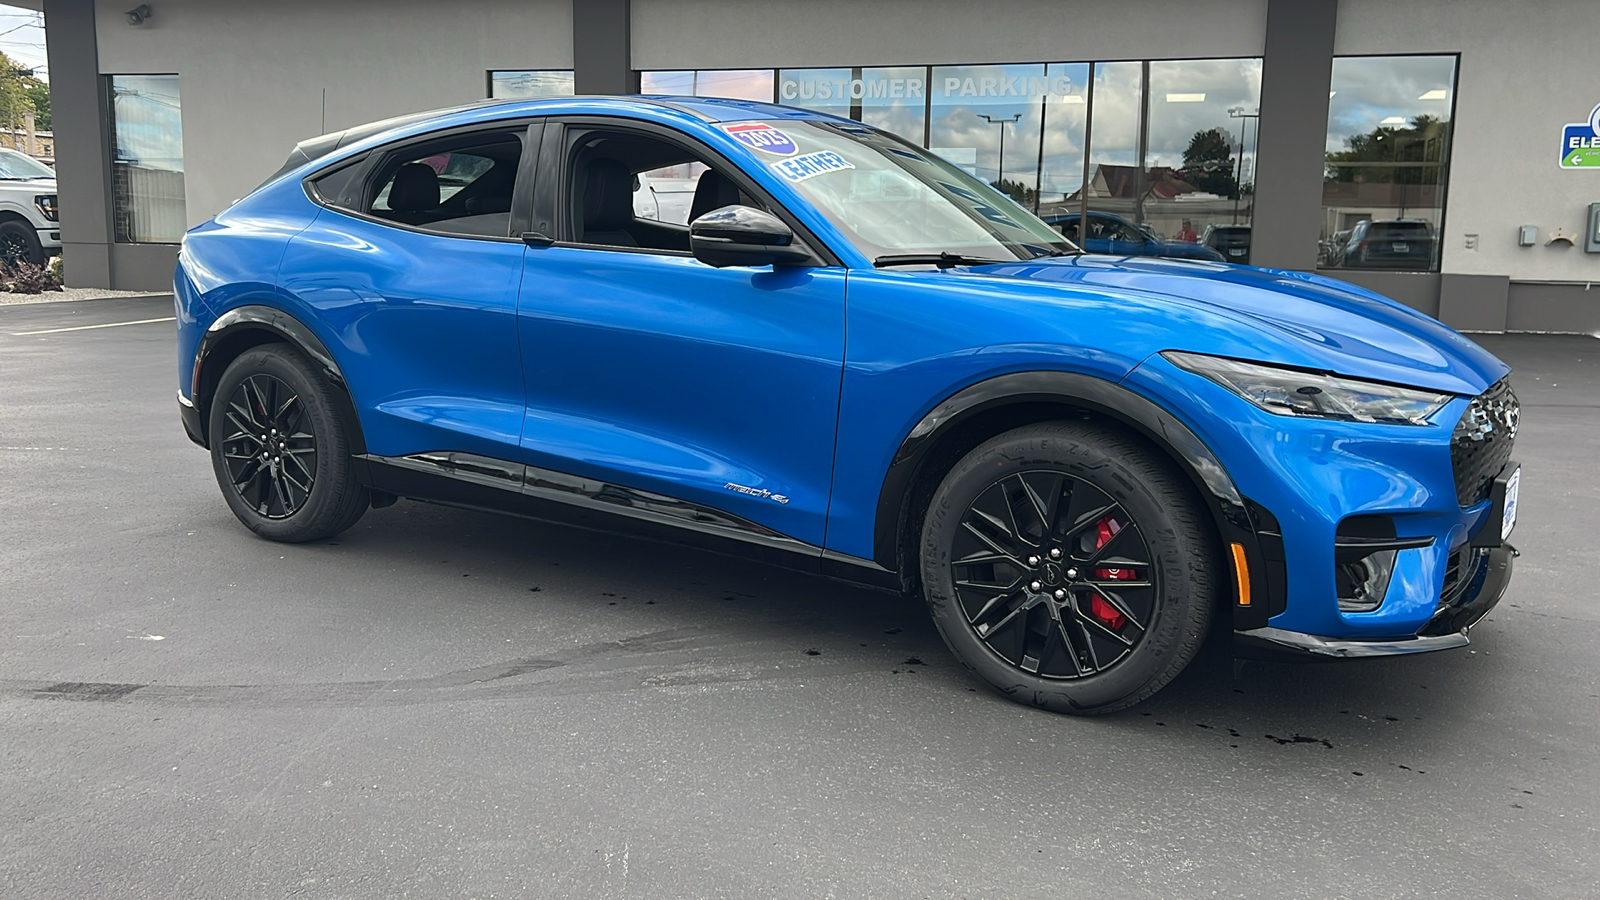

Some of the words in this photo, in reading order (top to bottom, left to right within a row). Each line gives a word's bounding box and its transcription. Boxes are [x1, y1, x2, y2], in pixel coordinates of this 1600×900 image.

[781, 79, 923, 100] CUSTOMER
[944, 75, 1072, 97] PARKING
[740, 129, 790, 147] 2025
[774, 152, 852, 180] LEATHER
